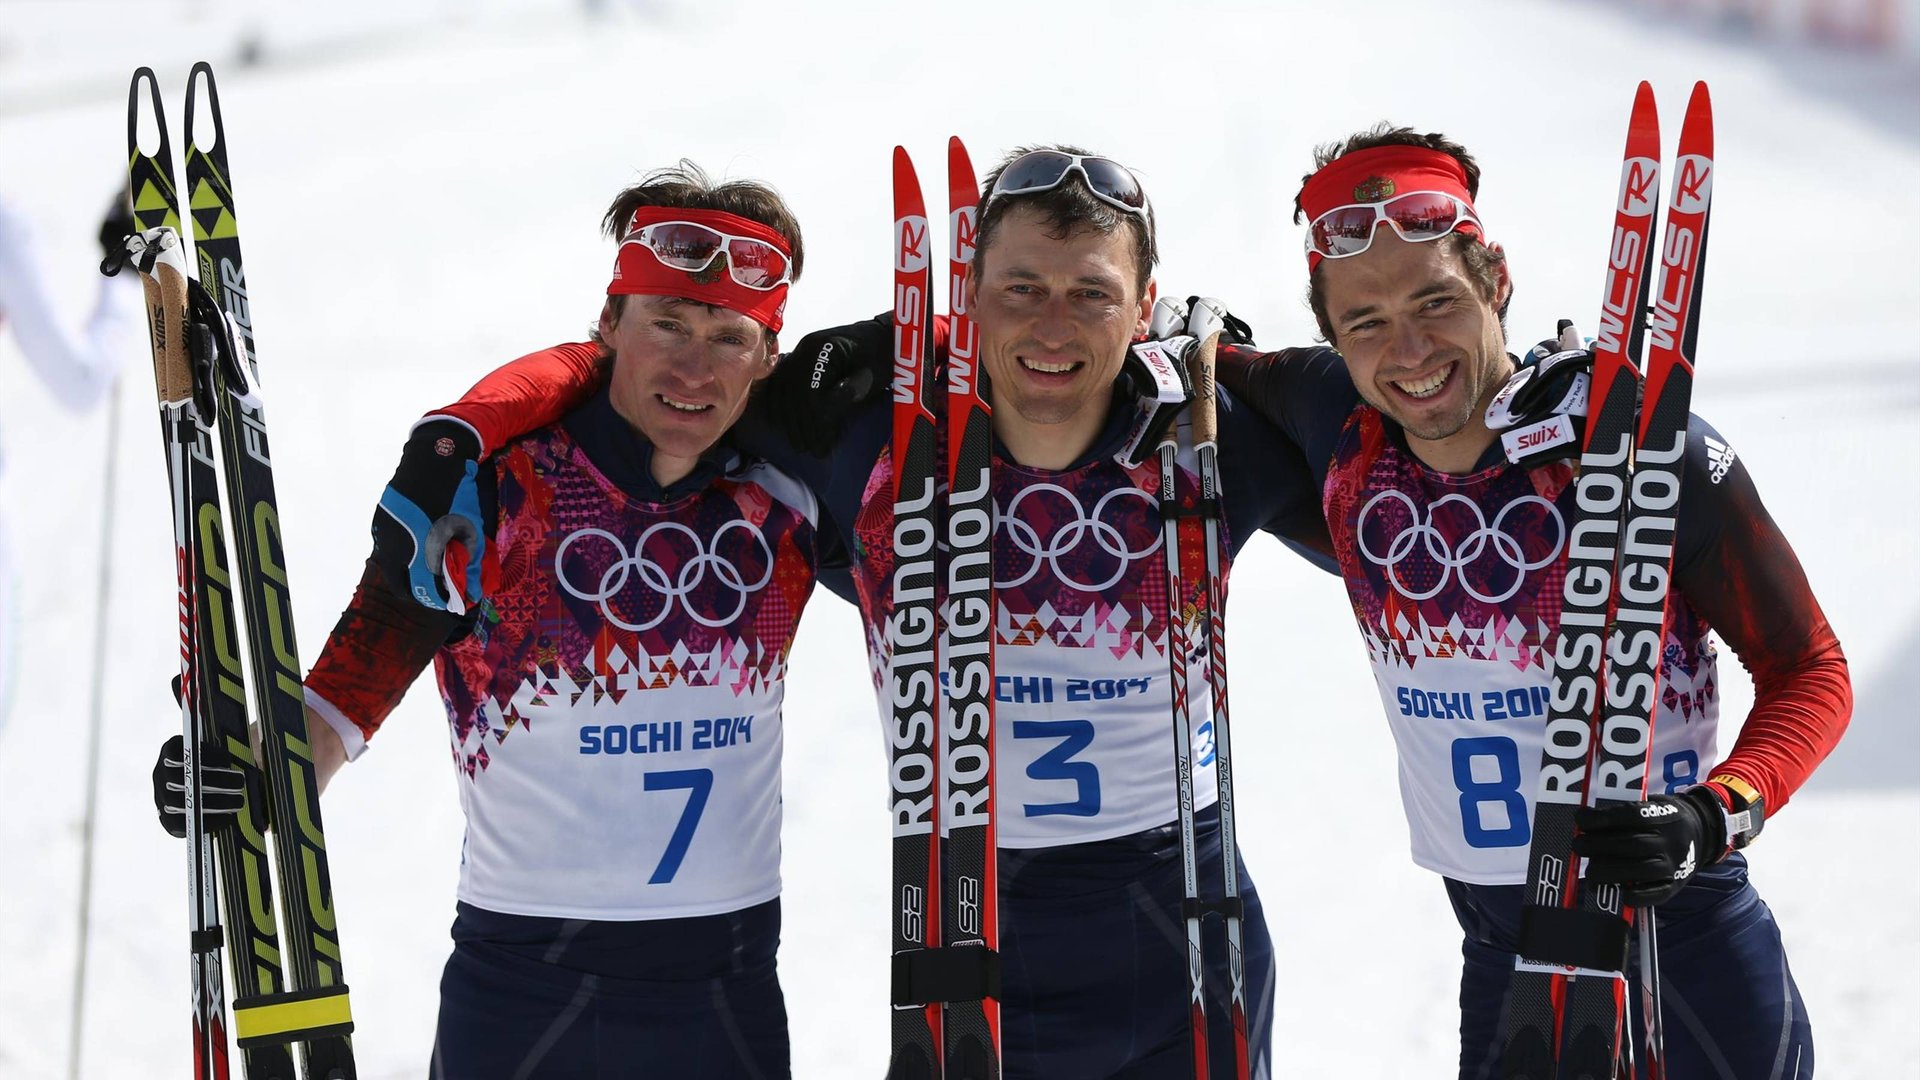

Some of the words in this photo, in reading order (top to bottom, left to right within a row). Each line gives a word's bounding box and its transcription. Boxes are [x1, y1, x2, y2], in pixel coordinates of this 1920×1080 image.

[1624, 162, 1656, 210] R
[1676, 159, 1710, 207] R
[902, 220, 925, 268] R
[1597, 225, 1641, 353] WCS
[1651, 222, 1694, 351] WCS
[811, 342, 834, 389] adidas
[893, 283, 920, 404] WCS
[1539, 432, 1630, 804] ROSSIGNOL
[1597, 430, 1686, 800] ROSSIGNOL
[893, 477, 935, 838] ROSSIGNOL
[949, 467, 990, 829] ROSSIGNOL
[1066, 677, 1152, 702] 2014
[1397, 686, 1475, 721] SOCHI
[579, 721, 682, 755] SOCHI
[692, 715, 754, 749] 2014
[183, 748, 193, 788] TRIAC
[1012, 719, 1101, 818] 3
[1180, 755, 1191, 791] TRIAC
[1219, 756, 1231, 791] TRIAC
[1451, 736, 1531, 848] 8
[1663, 749, 1699, 795] 8
[643, 767, 714, 885] 7
[903, 884, 922, 943] S2
[959, 876, 978, 935] S2
[1597, 883, 1620, 914] S
